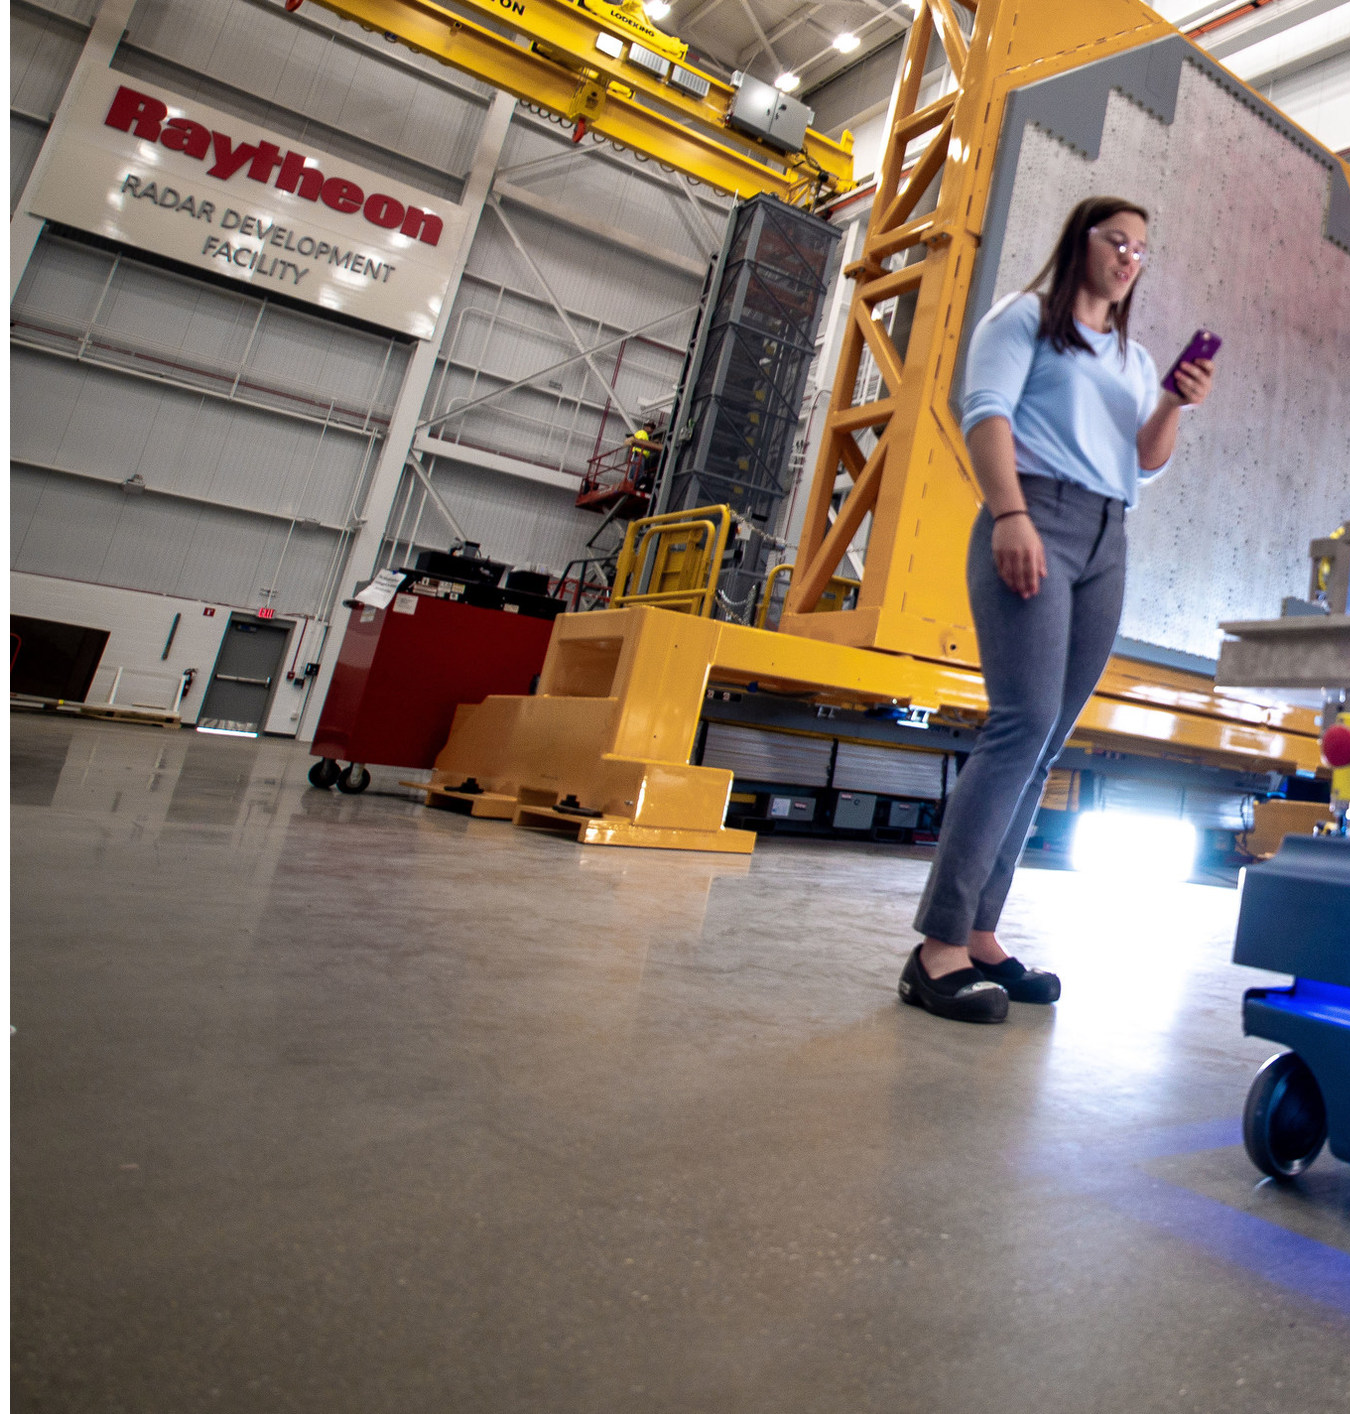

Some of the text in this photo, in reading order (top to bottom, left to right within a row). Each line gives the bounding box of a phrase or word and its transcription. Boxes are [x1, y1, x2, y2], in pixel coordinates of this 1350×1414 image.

[491, 0, 525, 17] ON
[610, 9, 655, 37] LODEKING
[104, 85, 444, 246] Raytheon
[120, 173, 396, 283] RADAR DEVELOPMENT
[202, 235, 311, 285] FACILITY
[258, 607, 275, 619] EXIT
